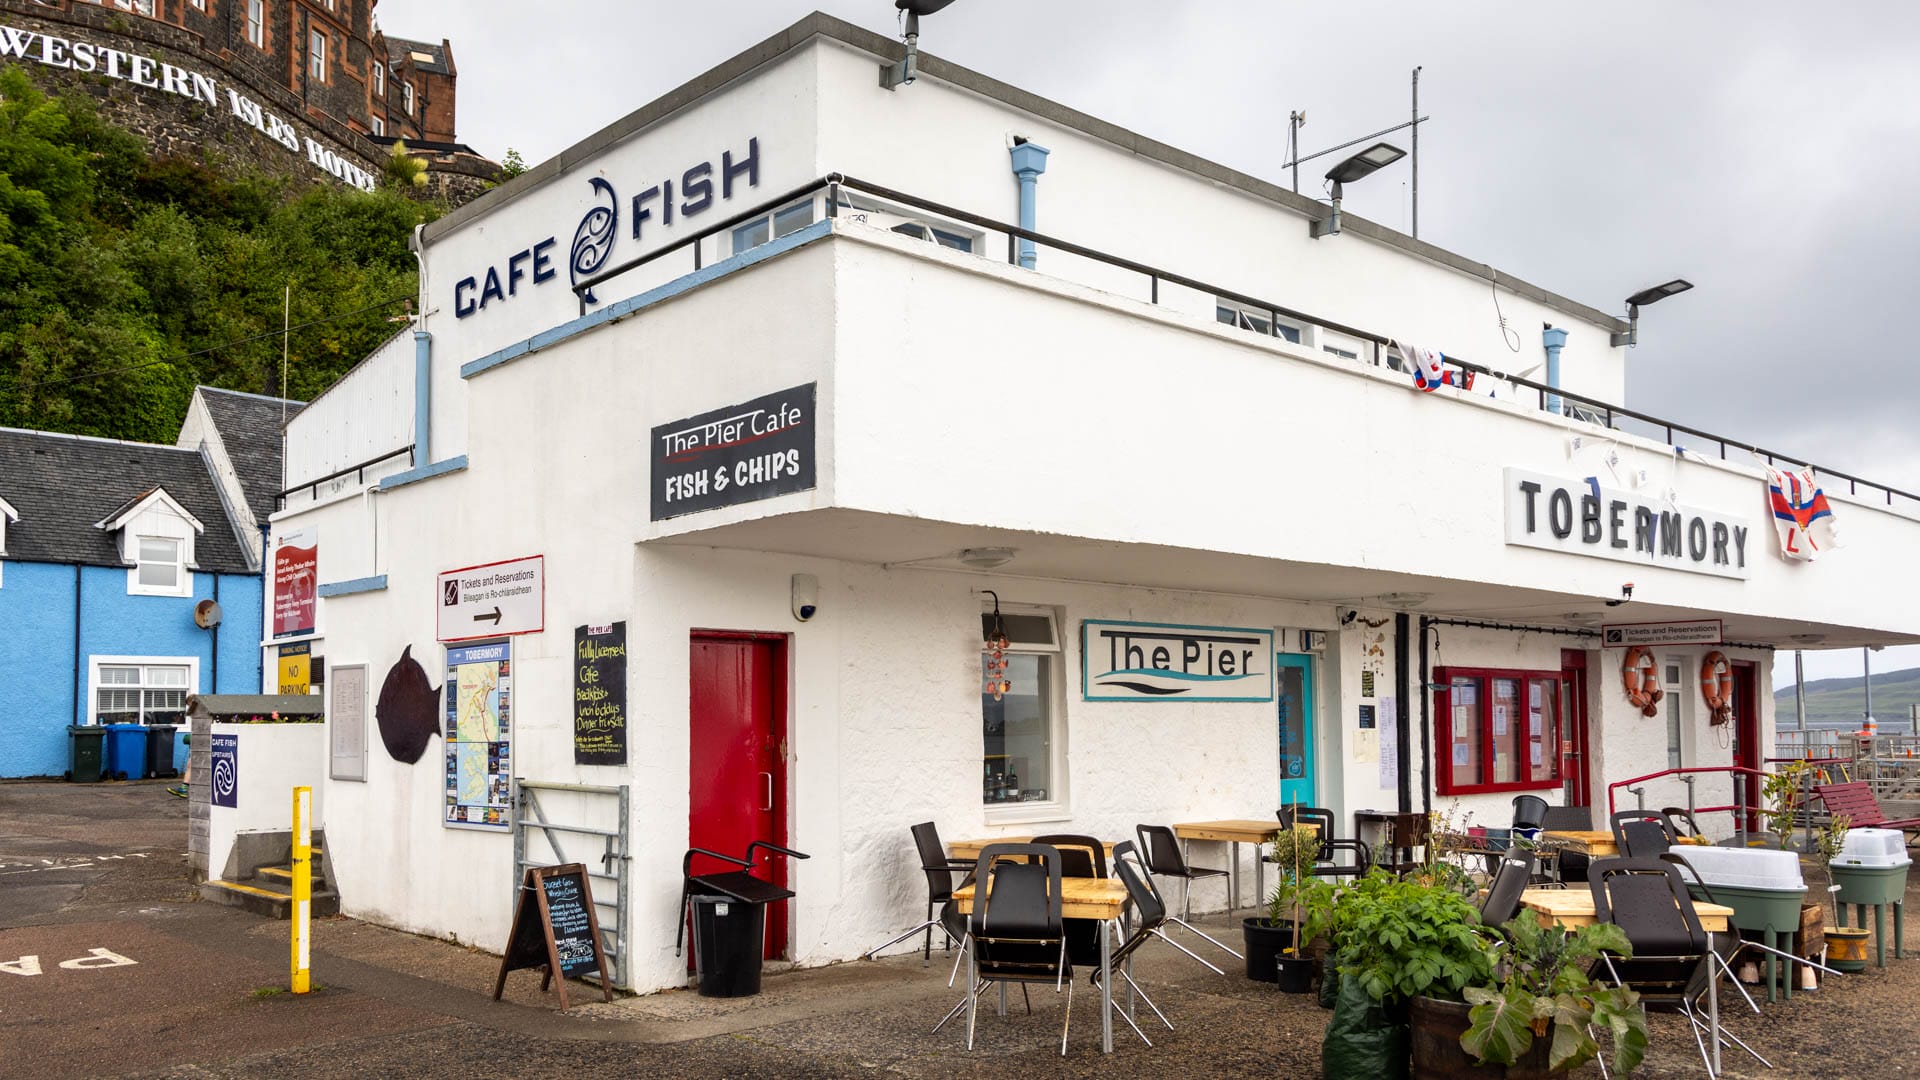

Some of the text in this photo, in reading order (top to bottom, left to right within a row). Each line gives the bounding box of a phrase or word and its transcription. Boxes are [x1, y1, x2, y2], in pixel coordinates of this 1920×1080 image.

[0, 25, 217, 107] WESTERN
[225, 87, 301, 153] ISLES
[454, 136, 760, 320] CAFE FISH
[662, 402, 802, 457] The Pier Cafe
[665, 448, 800, 503] FISH & CHIPS
[1519, 480, 1748, 568] TOBERMORY
[461, 569, 535, 590] Tickets and Reservations
[1624, 624, 1718, 636] Tickets and Reservations
[465, 647, 503, 661] TOBERMORY
[1100, 630, 1253, 676] The Pier
[288, 664, 299, 678] NO
[580, 665, 599, 684] Cafe
[280, 682, 307, 696] PARKING
[212, 738, 237, 747] CAFE FISH
